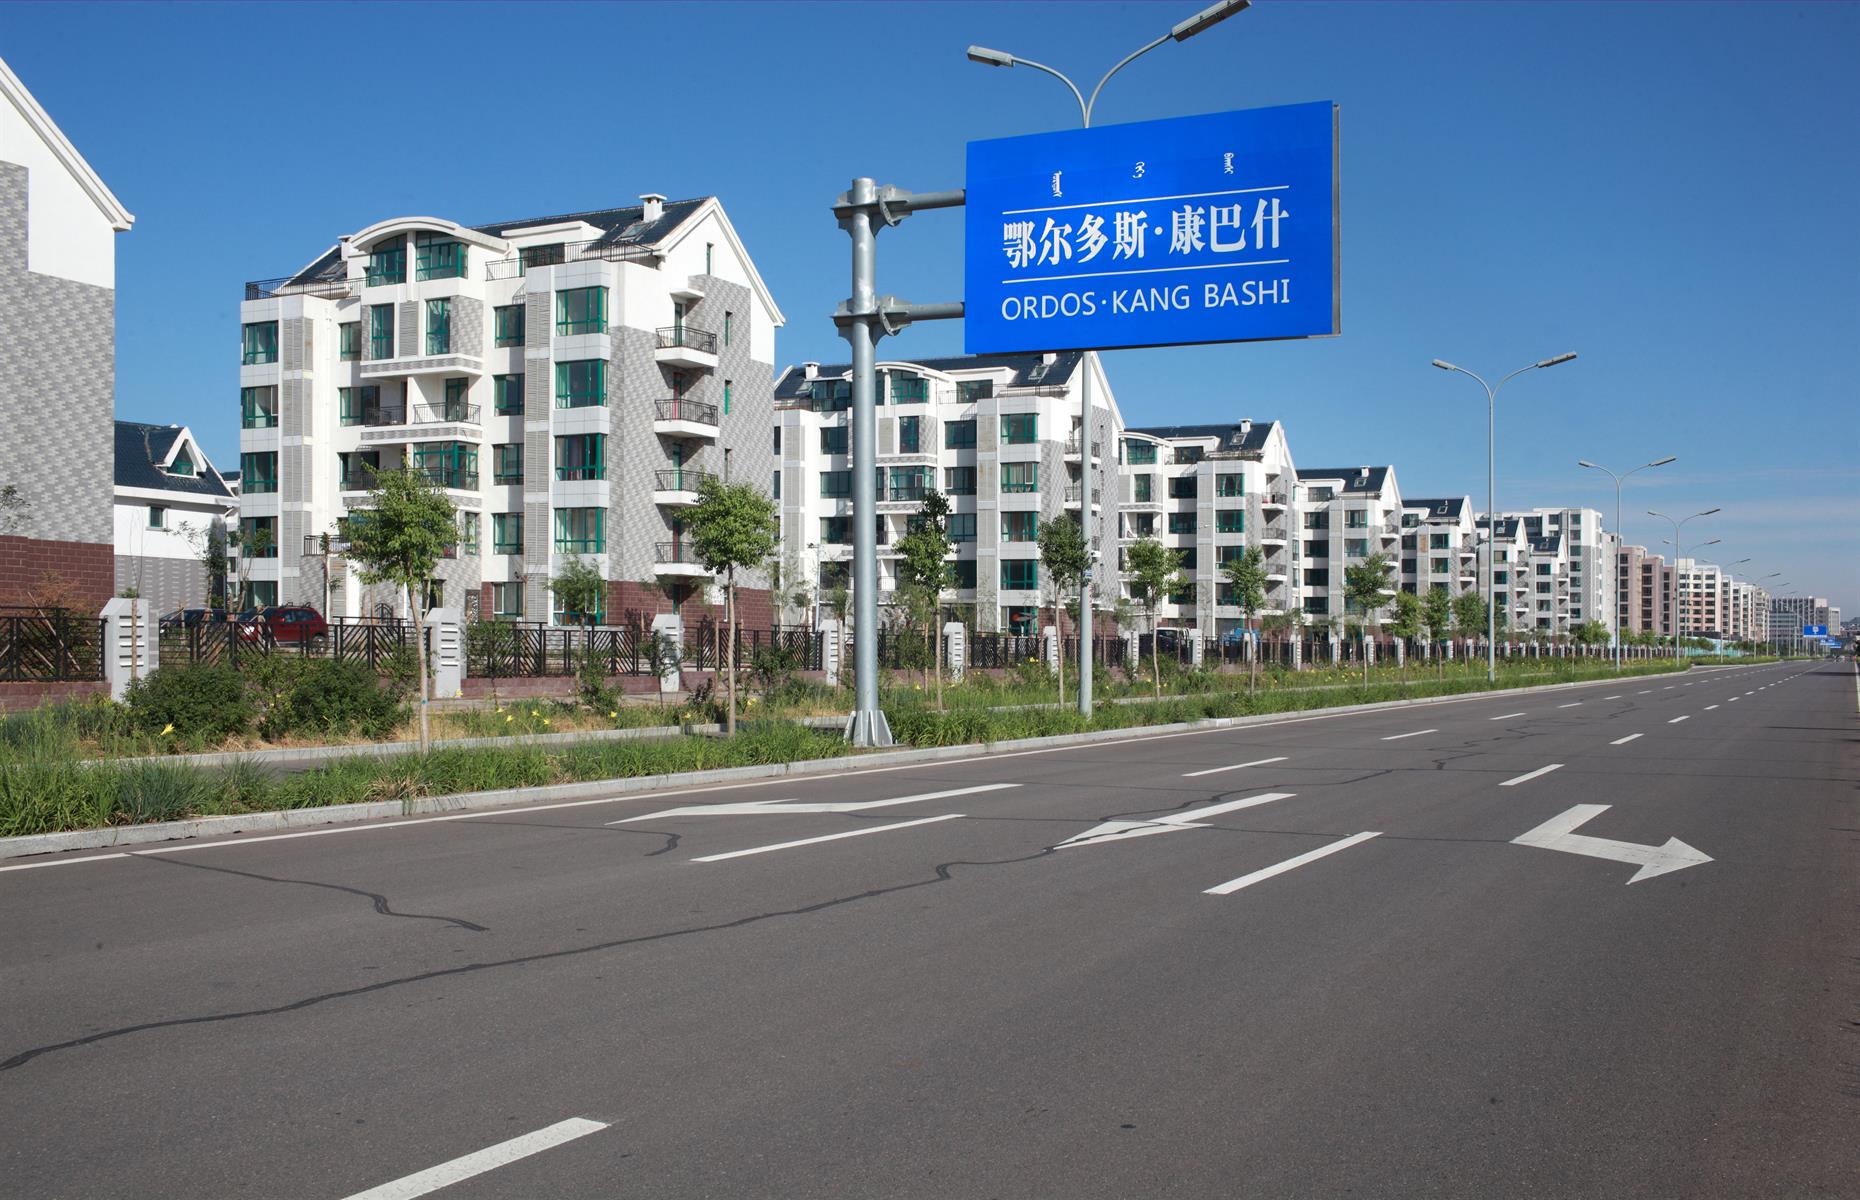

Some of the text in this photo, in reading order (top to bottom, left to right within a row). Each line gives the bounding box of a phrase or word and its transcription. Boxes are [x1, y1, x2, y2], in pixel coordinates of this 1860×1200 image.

[1002, 197, 1290, 269] 鄂尔多斯·康巴什
[1204, 278, 1290, 308] BASHI
